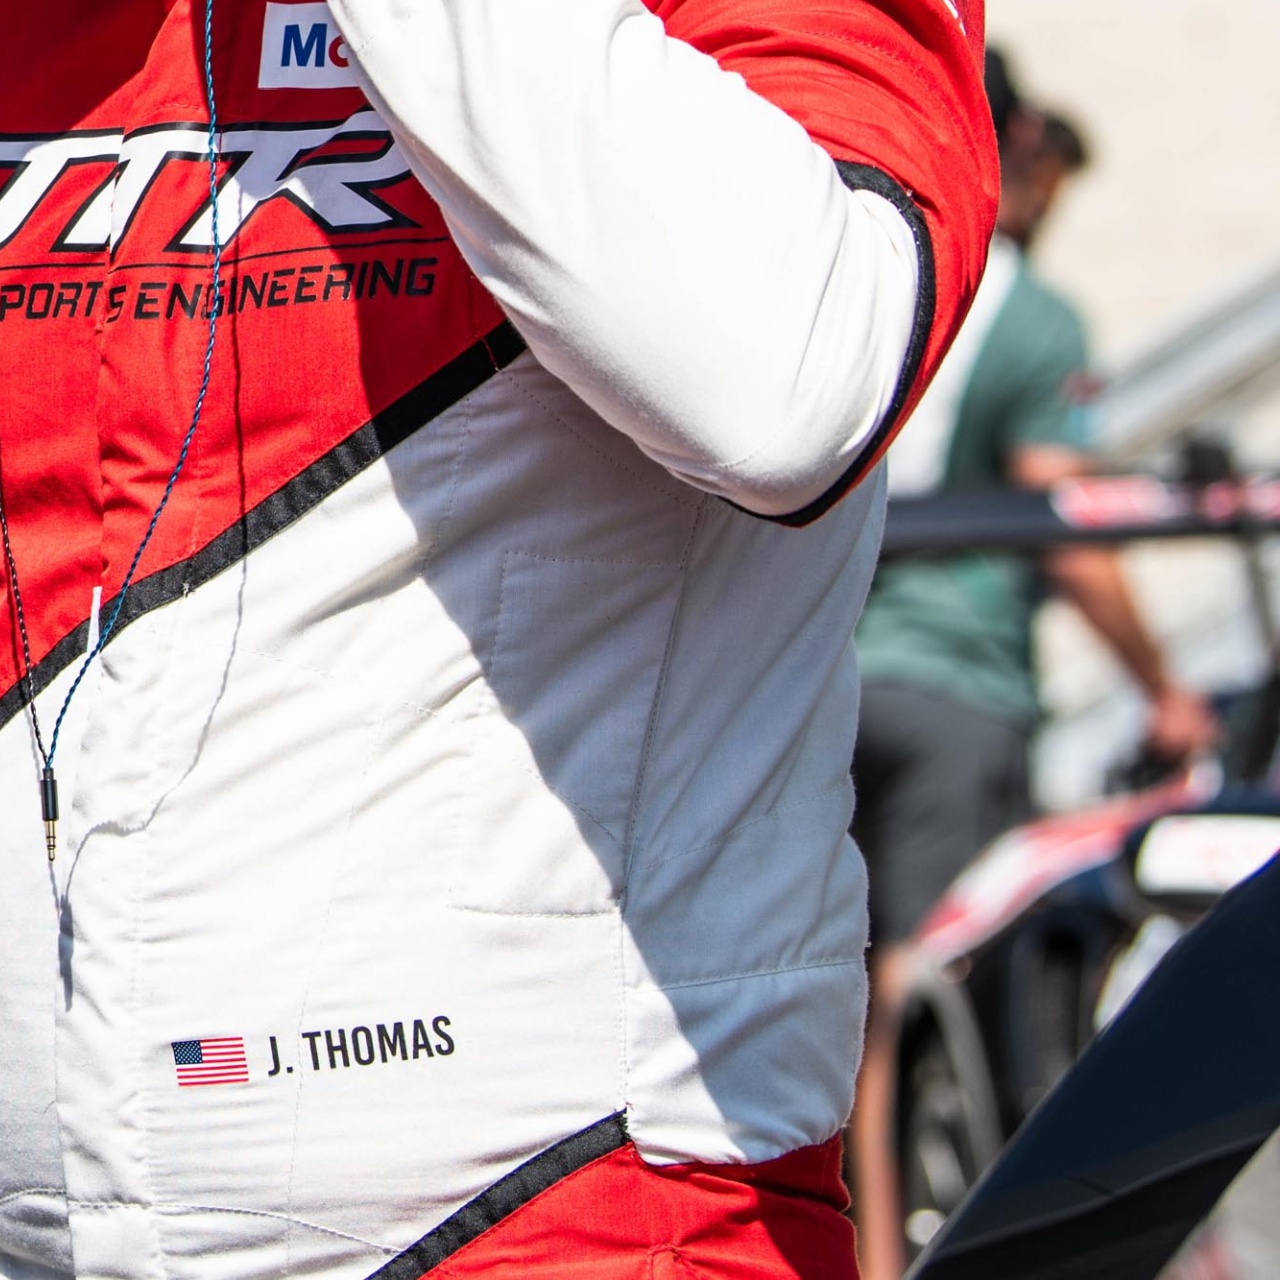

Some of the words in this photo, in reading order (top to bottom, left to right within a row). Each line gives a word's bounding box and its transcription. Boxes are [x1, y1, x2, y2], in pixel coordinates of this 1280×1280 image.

[139, 257, 438, 321] ENGINEERING
[268, 1036, 294, 1077] J.
[302, 1015, 455, 1071] THOMAS
